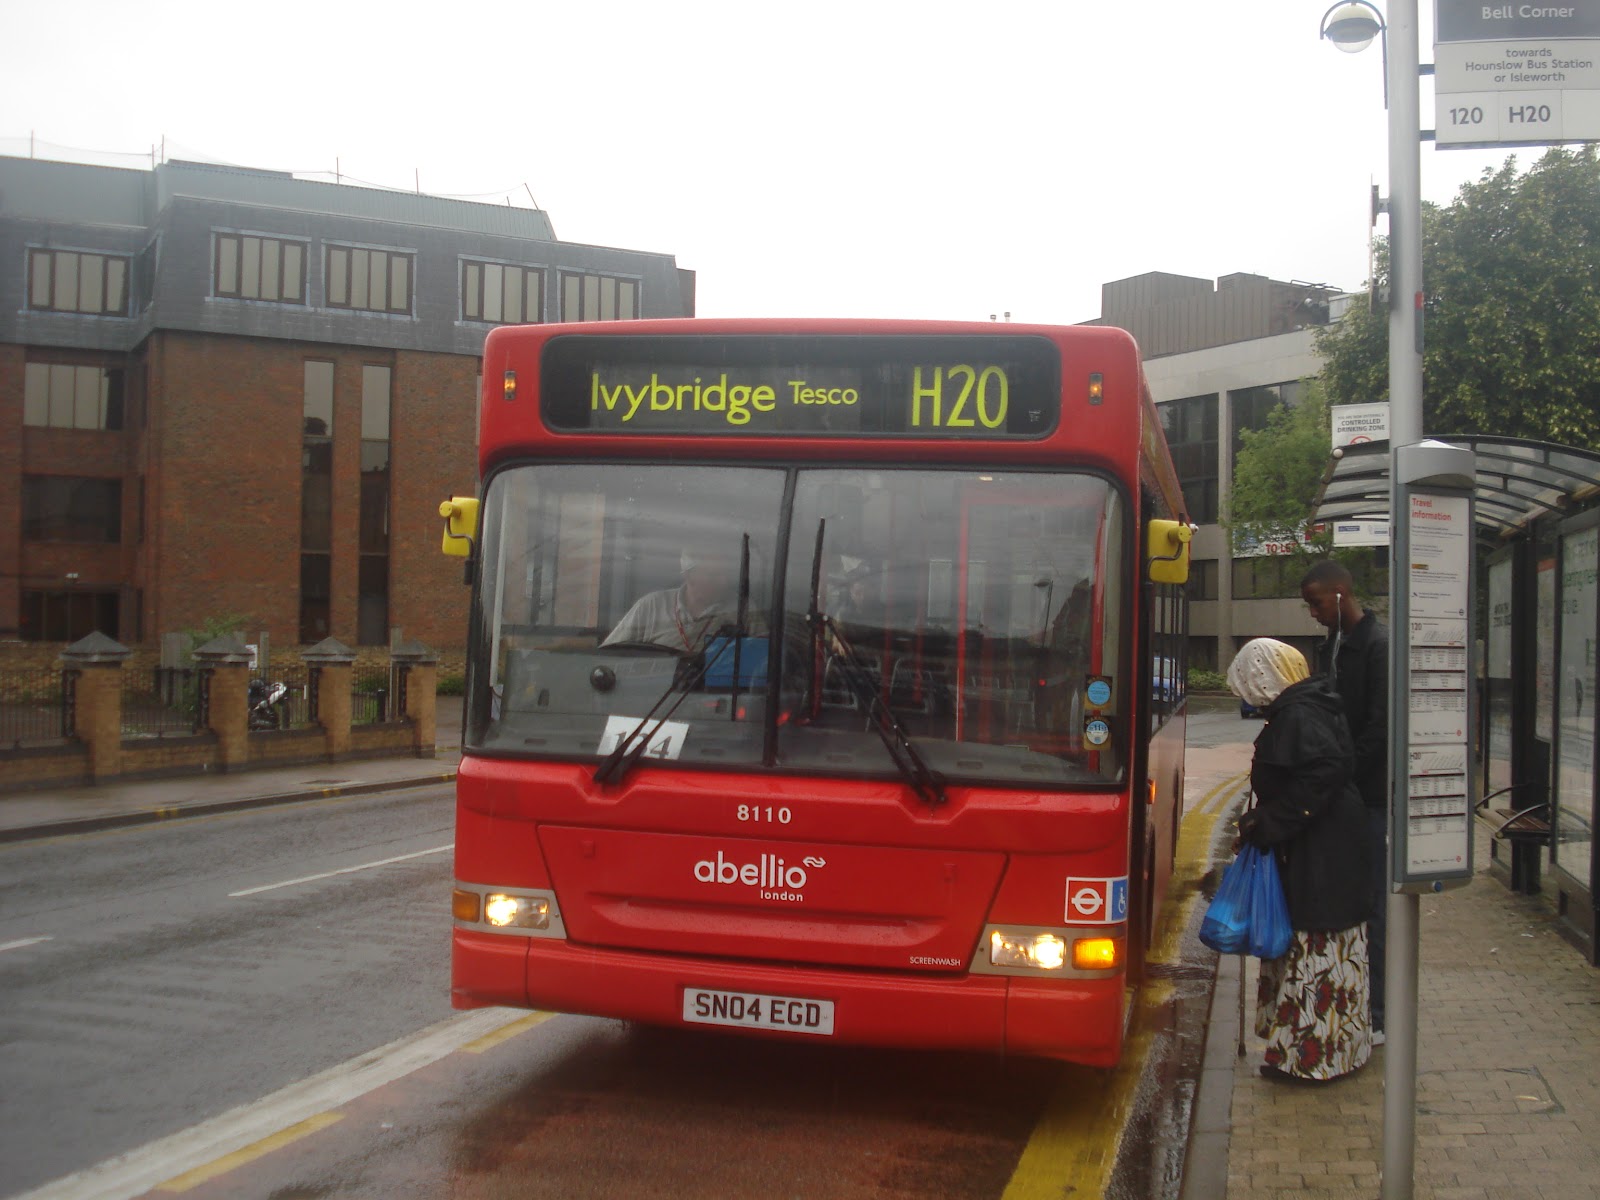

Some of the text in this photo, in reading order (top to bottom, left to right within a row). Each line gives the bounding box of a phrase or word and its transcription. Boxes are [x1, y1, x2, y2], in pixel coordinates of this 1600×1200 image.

[1482, 5, 1575, 20] Bell Corner
[1506, 48, 1553, 58] towards
[1465, 59, 1593, 72] Hounslow Bus Station
[1494, 72, 1566, 83] or Isleworth
[1450, 105, 1551, 125] 120 H20
[591, 363, 1009, 428] Ivybridge Tesco H20
[1341, 418, 1381, 426] CONTROLLED
[1412, 497, 1432, 508] Travel
[1412, 510, 1452, 521] information
[1265, 543, 1278, 554] TO
[737, 804, 792, 824] 8110
[694, 851, 807, 889] abellio
[760, 889, 803, 902] london
[909, 956, 961, 967] SCREENWASH
[695, 993, 821, 1027] SN04 EGD
